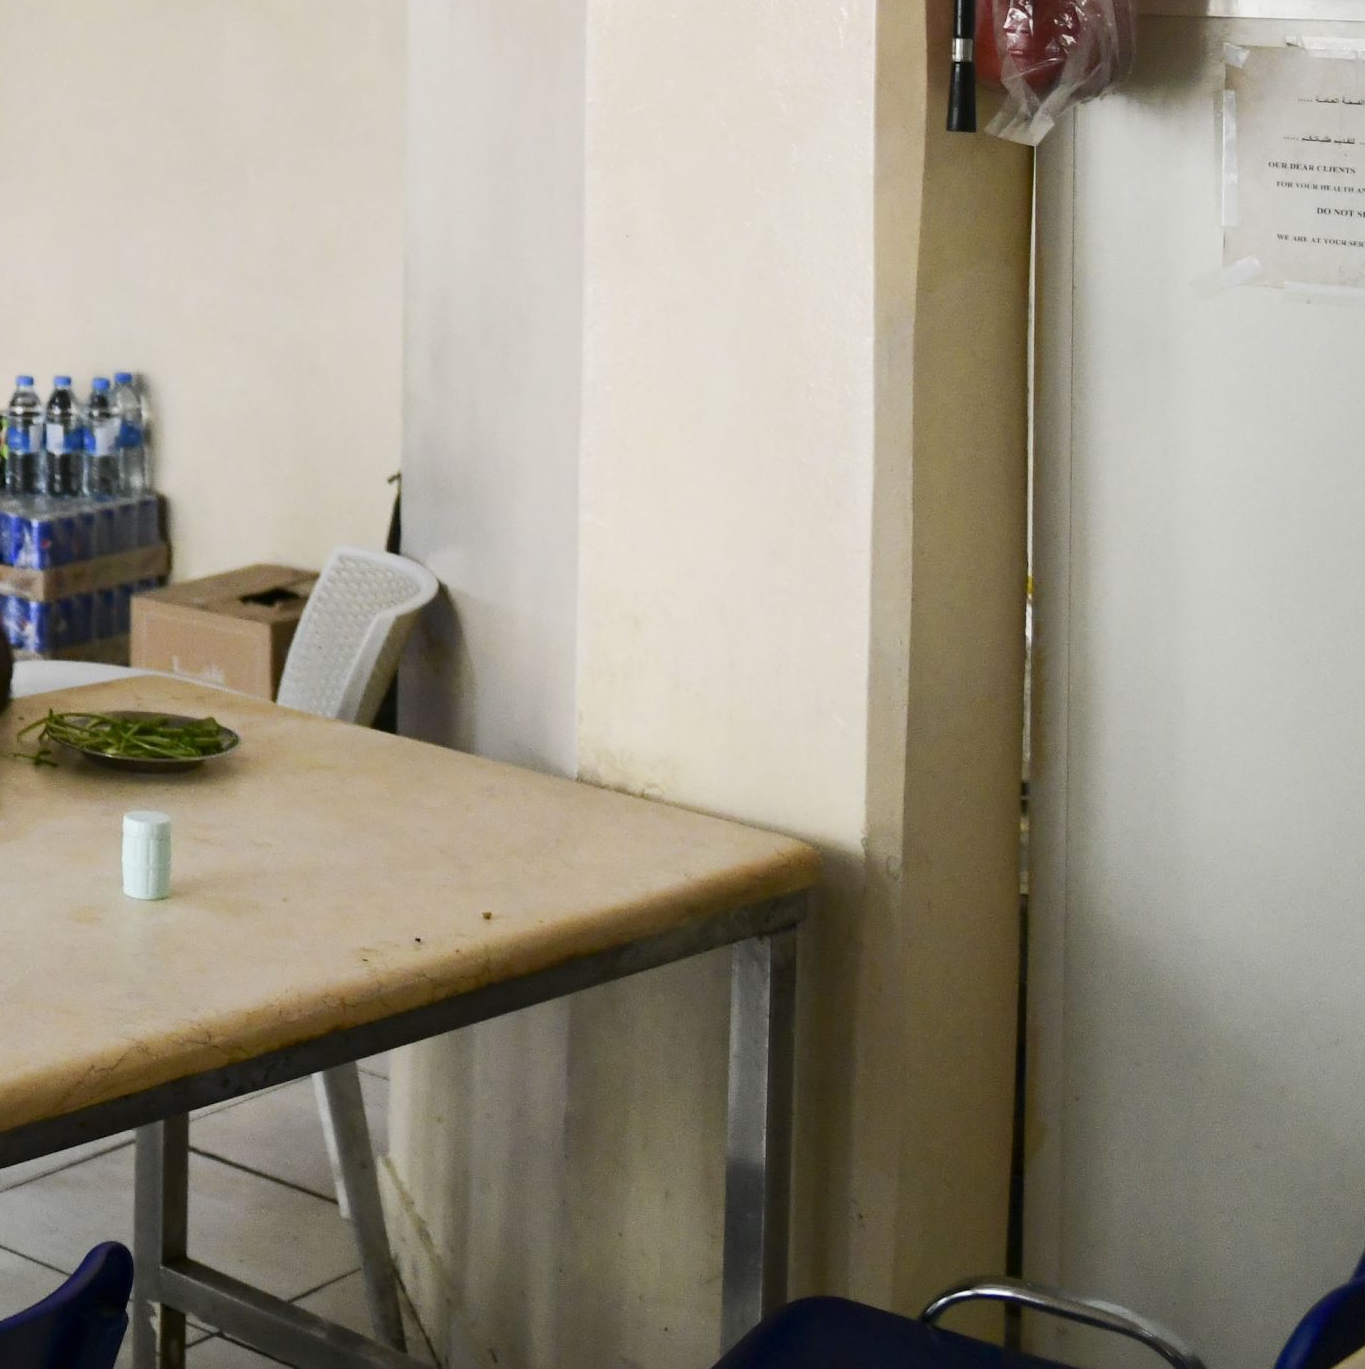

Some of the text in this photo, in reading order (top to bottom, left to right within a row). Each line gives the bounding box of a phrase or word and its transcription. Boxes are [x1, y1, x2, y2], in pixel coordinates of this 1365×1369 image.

[1268, 161, 1356, 174] OUR DEAR CLIENTS
[1317, 207, 1331, 215] DO
[1334, 208, 1354, 217] NOT
[1324, 238, 1347, 246] YOUR
